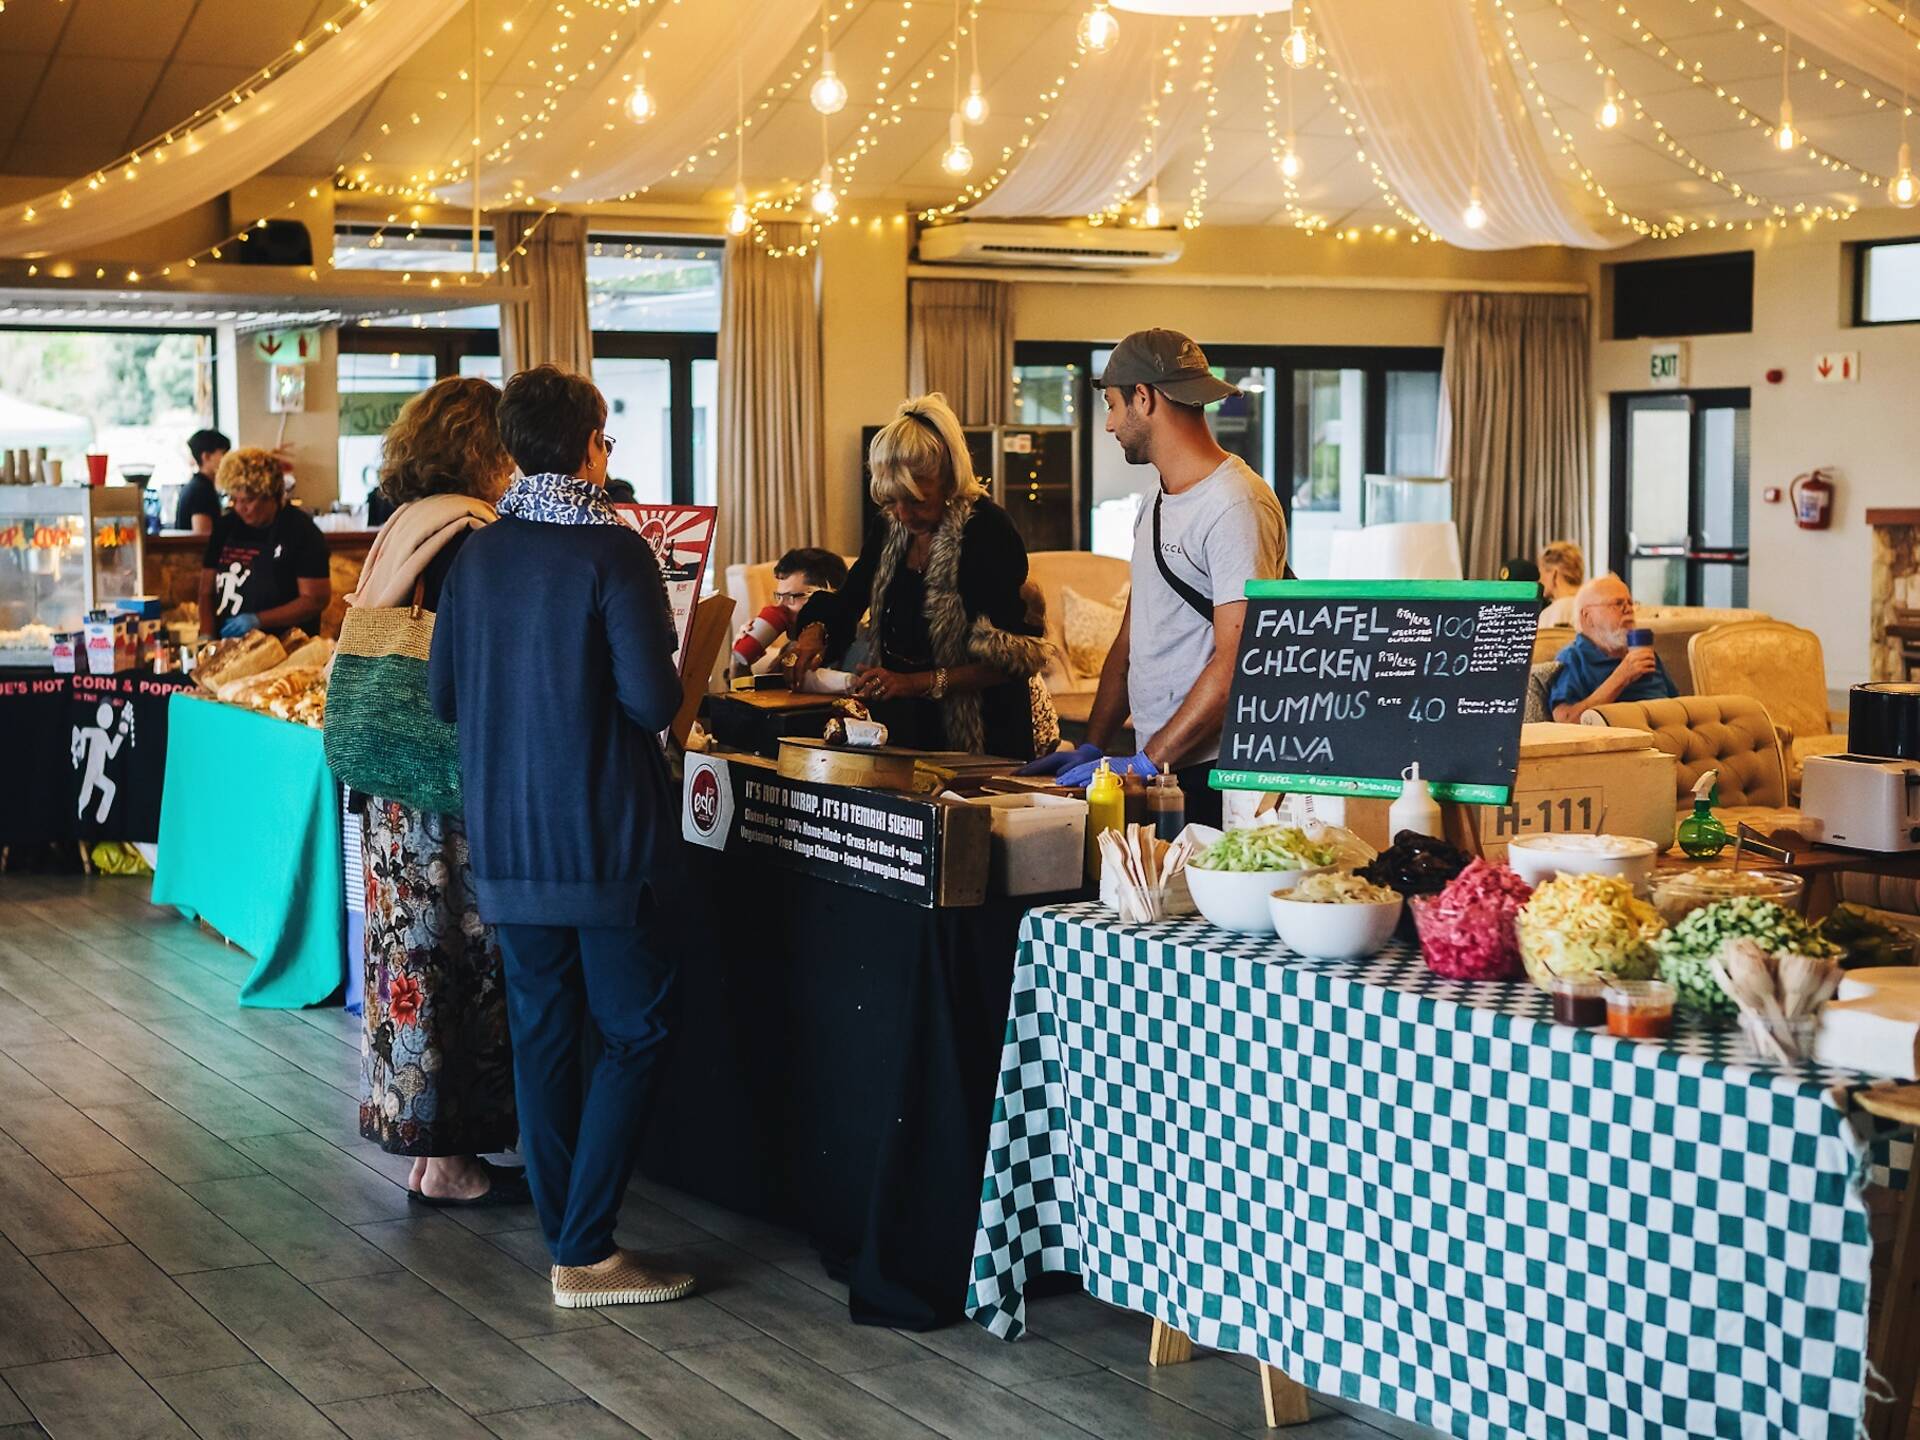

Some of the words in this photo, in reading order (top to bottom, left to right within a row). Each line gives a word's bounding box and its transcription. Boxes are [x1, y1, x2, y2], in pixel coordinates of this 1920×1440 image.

[1651, 354, 1677, 378] EXIT
[1255, 605, 1389, 641] FALAFEL
[1435, 614, 1476, 640] 100
[1241, 645, 1372, 682] CHICKEN
[1423, 650, 1469, 676] 120
[32, 678, 65, 693] HOT
[72, 675, 117, 692] CORN
[123, 679, 133, 692] &
[1236, 690, 1370, 724] HUMMUS
[1408, 696, 1446, 723] 40
[1232, 733, 1334, 763] HALVA
[745, 780, 761, 800] IT'S
[763, 784, 780, 805] NOT
[782, 788, 788, 807] A
[791, 790, 820, 818] WRAP,
[822, 797, 839, 820] IT'S
[841, 802, 848, 822] A
[850, 803, 887, 831] TEMAKI
[1496, 797, 1591, 836] H-111
[784, 818, 802, 833] 100%
[846, 832, 866, 850] Grass
[866, 837, 878, 854] Fed
[879, 840, 895, 858] Beef
[900, 846, 922, 866] Vegan
[794, 838, 814, 858] Range
[815, 844, 839, 863] Chicken
[843, 851, 862, 869] Fresh
[862, 857, 899, 879] Norwegian
[900, 867, 925, 887] Salmon
